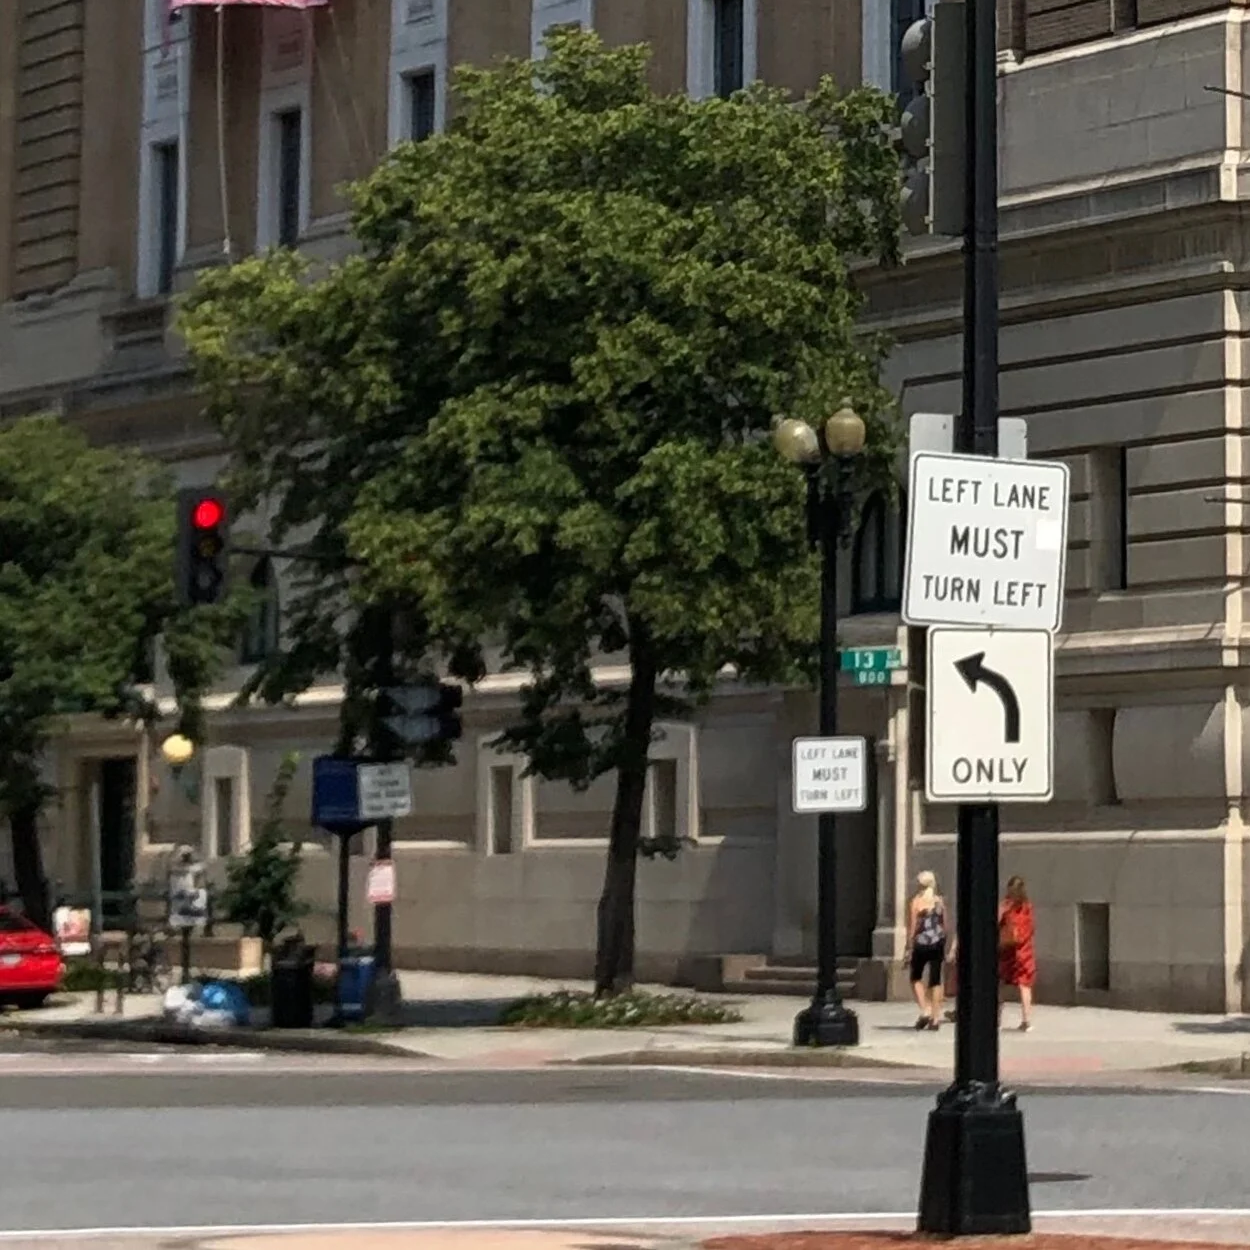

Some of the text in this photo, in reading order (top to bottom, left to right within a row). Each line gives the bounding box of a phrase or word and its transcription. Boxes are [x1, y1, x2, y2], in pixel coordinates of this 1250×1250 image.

[928, 477, 1050, 510] LEFT LANE
[950, 525, 1024, 560] MUST
[922, 575, 1047, 608] TURN LEFT
[854, 651, 875, 669] 13
[801, 747, 859, 760] LEFT LANE
[812, 767, 848, 781] MUST
[952, 758, 1028, 784] ONLY
[800, 788, 859, 801] TURN LEFT
